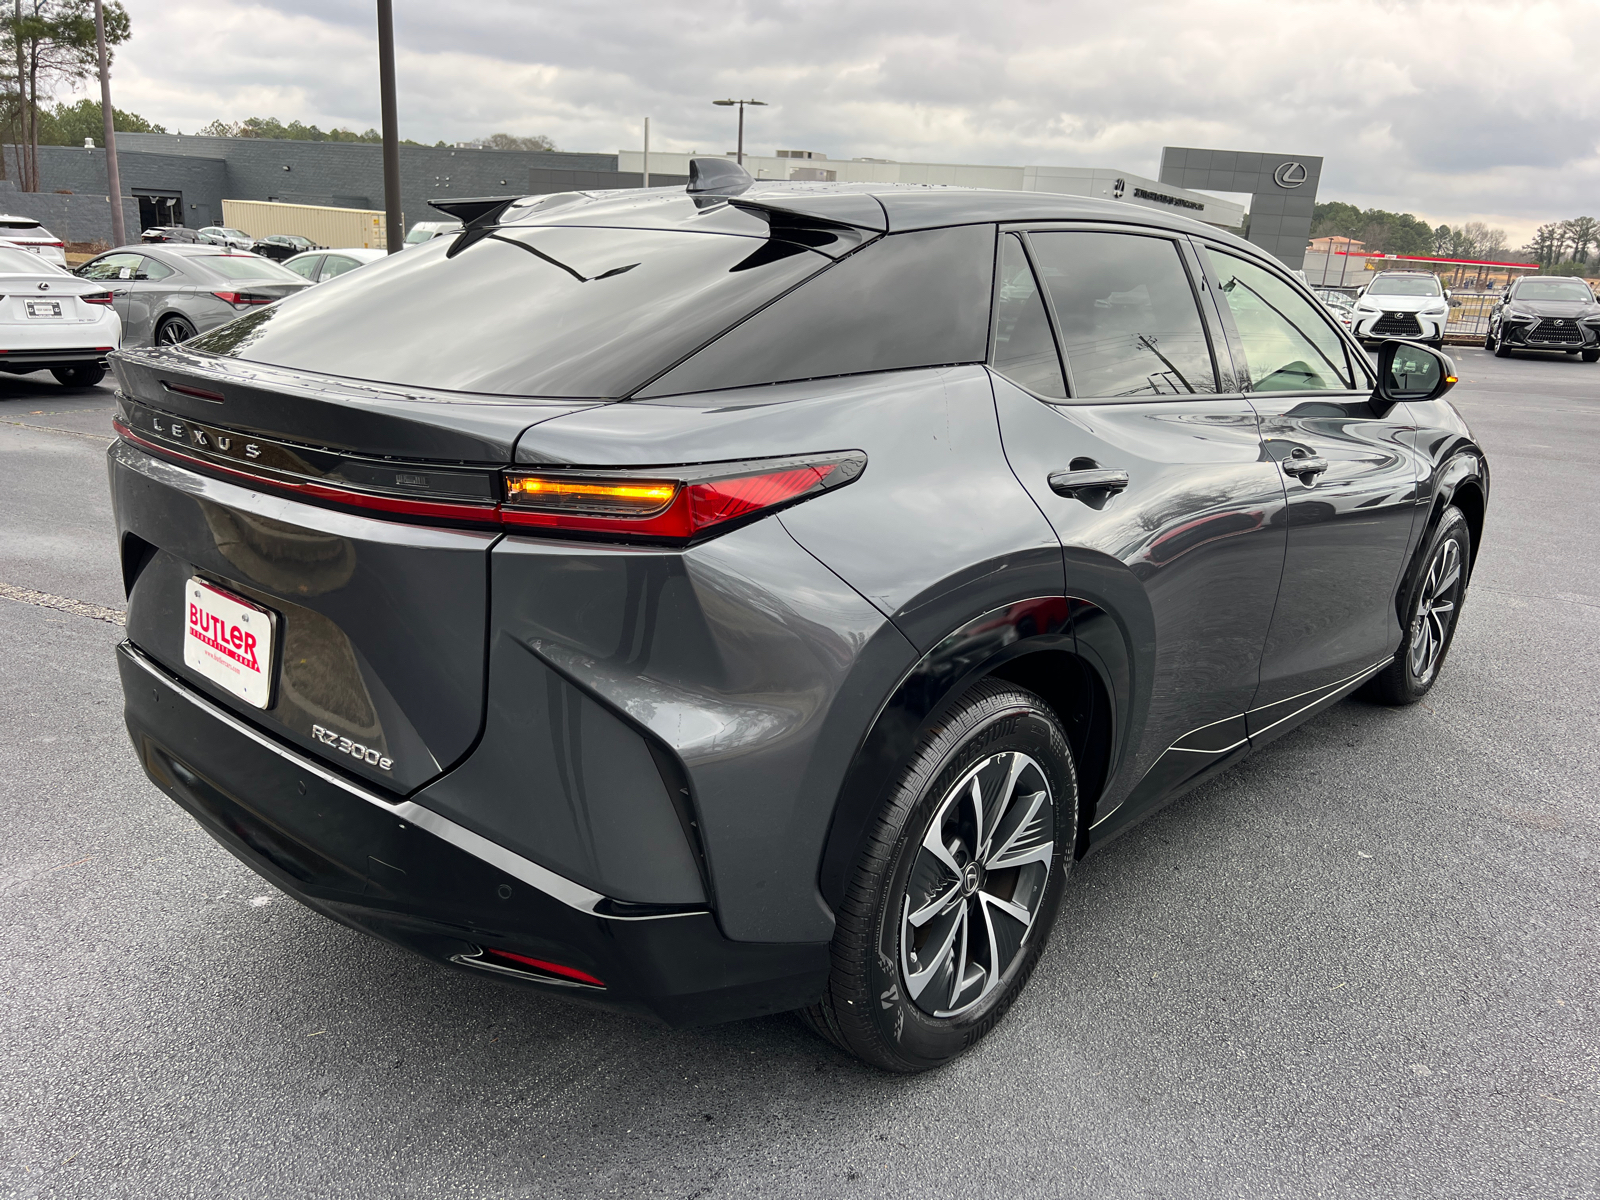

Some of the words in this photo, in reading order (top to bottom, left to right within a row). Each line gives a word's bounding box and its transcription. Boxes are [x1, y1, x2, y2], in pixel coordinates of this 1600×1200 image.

[152, 417, 262, 460] LEXUS
[311, 724, 394, 770] RZ300e
[917, 714, 1020, 828] BRIDGESTONE
[1064, 745, 1079, 841] TURANZA
